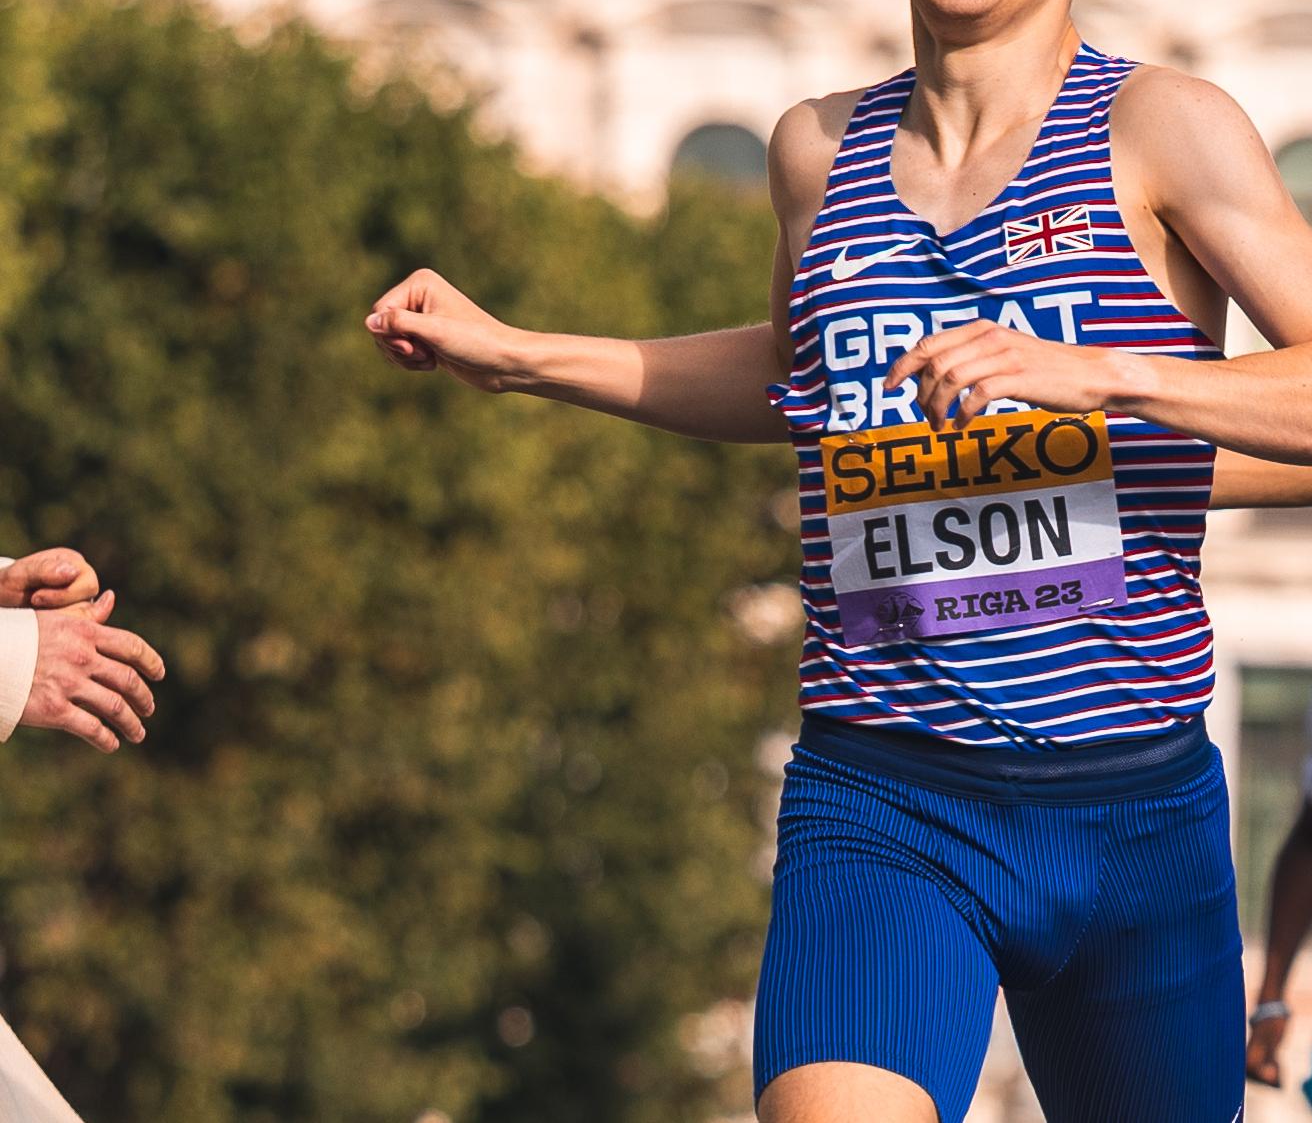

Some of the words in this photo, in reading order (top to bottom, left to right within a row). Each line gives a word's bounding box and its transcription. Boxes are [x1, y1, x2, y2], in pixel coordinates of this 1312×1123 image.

[831, 416, 1099, 504] SEIKO
[863, 494, 1073, 580] ELSON
[934, 590, 1030, 623] RIGA
[1034, 579, 1084, 610] 23
